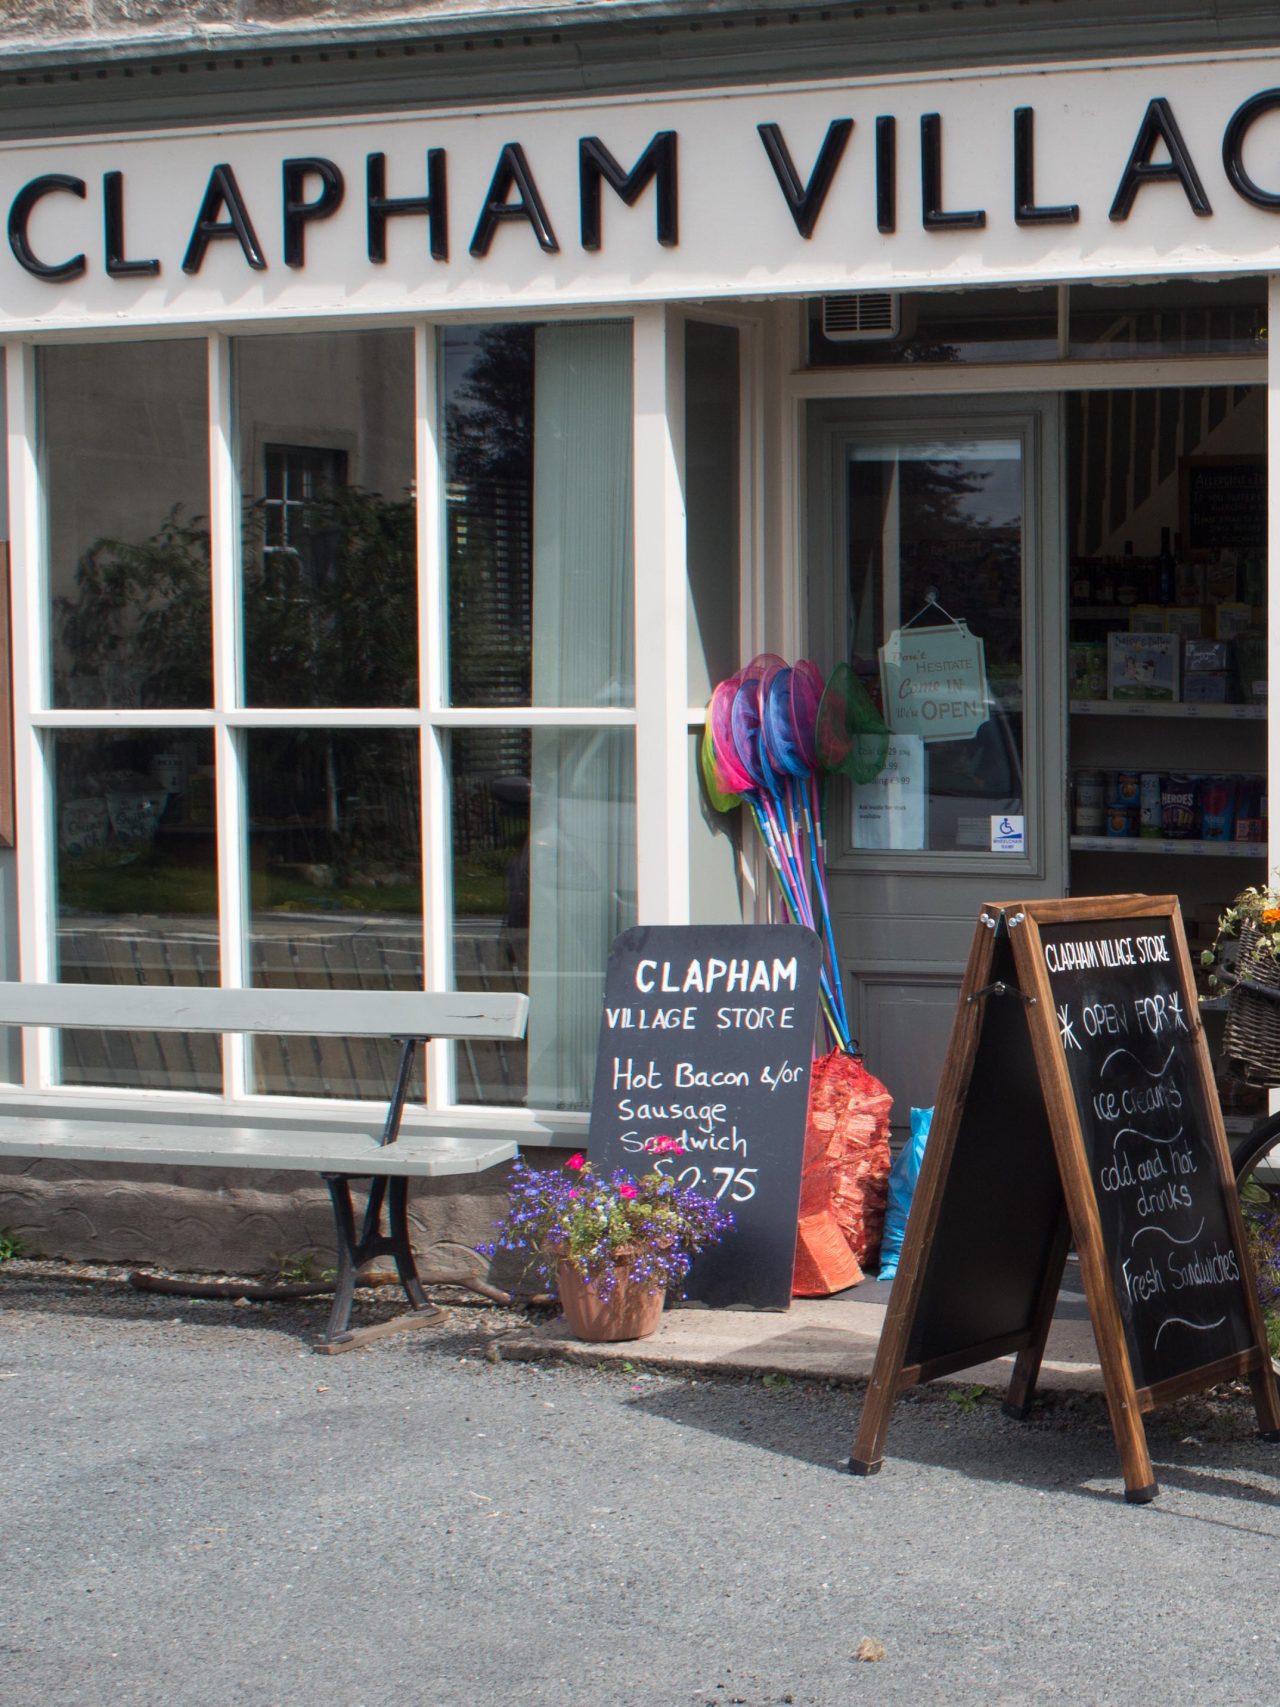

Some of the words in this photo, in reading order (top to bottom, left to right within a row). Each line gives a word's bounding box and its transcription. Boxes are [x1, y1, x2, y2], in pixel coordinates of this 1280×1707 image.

[7, 130, 678, 284] CLAPHAM
[916, 658, 974, 674] HESITATE
[899, 678, 940, 700] Come
[946, 678, 964, 694] IN
[921, 700, 977, 721] OPEN
[1161, 792, 1194, 806] HEROES
[1045, 941, 1099, 973] CLAPHAM
[1096, 938, 1137, 967] VILLAGE
[1136, 935, 1170, 964] STORE
[635, 957, 797, 993] CLAPHAM
[606, 1007, 697, 1029] VILLAGE
[716, 1007, 795, 1029] STORE
[1083, 1003, 1129, 1036] OPEN
[1134, 994, 1169, 1034] FOR
[613, 1057, 662, 1090] Hot
[676, 1063, 749, 1088] Bacon
[760, 1060, 803, 1091] &/or
[617, 1098, 727, 1133] Sausage
[1094, 1091, 1120, 1120] ice
[1101, 1152, 1136, 1191] cold
[1137, 1149, 1167, 1182] and
[1170, 1140, 1198, 1175] hot
[1137, 1182, 1192, 1216] drinks
[1123, 1258, 1166, 1303] Fresh
[1168, 1241, 1240, 1290] Sandwiches
